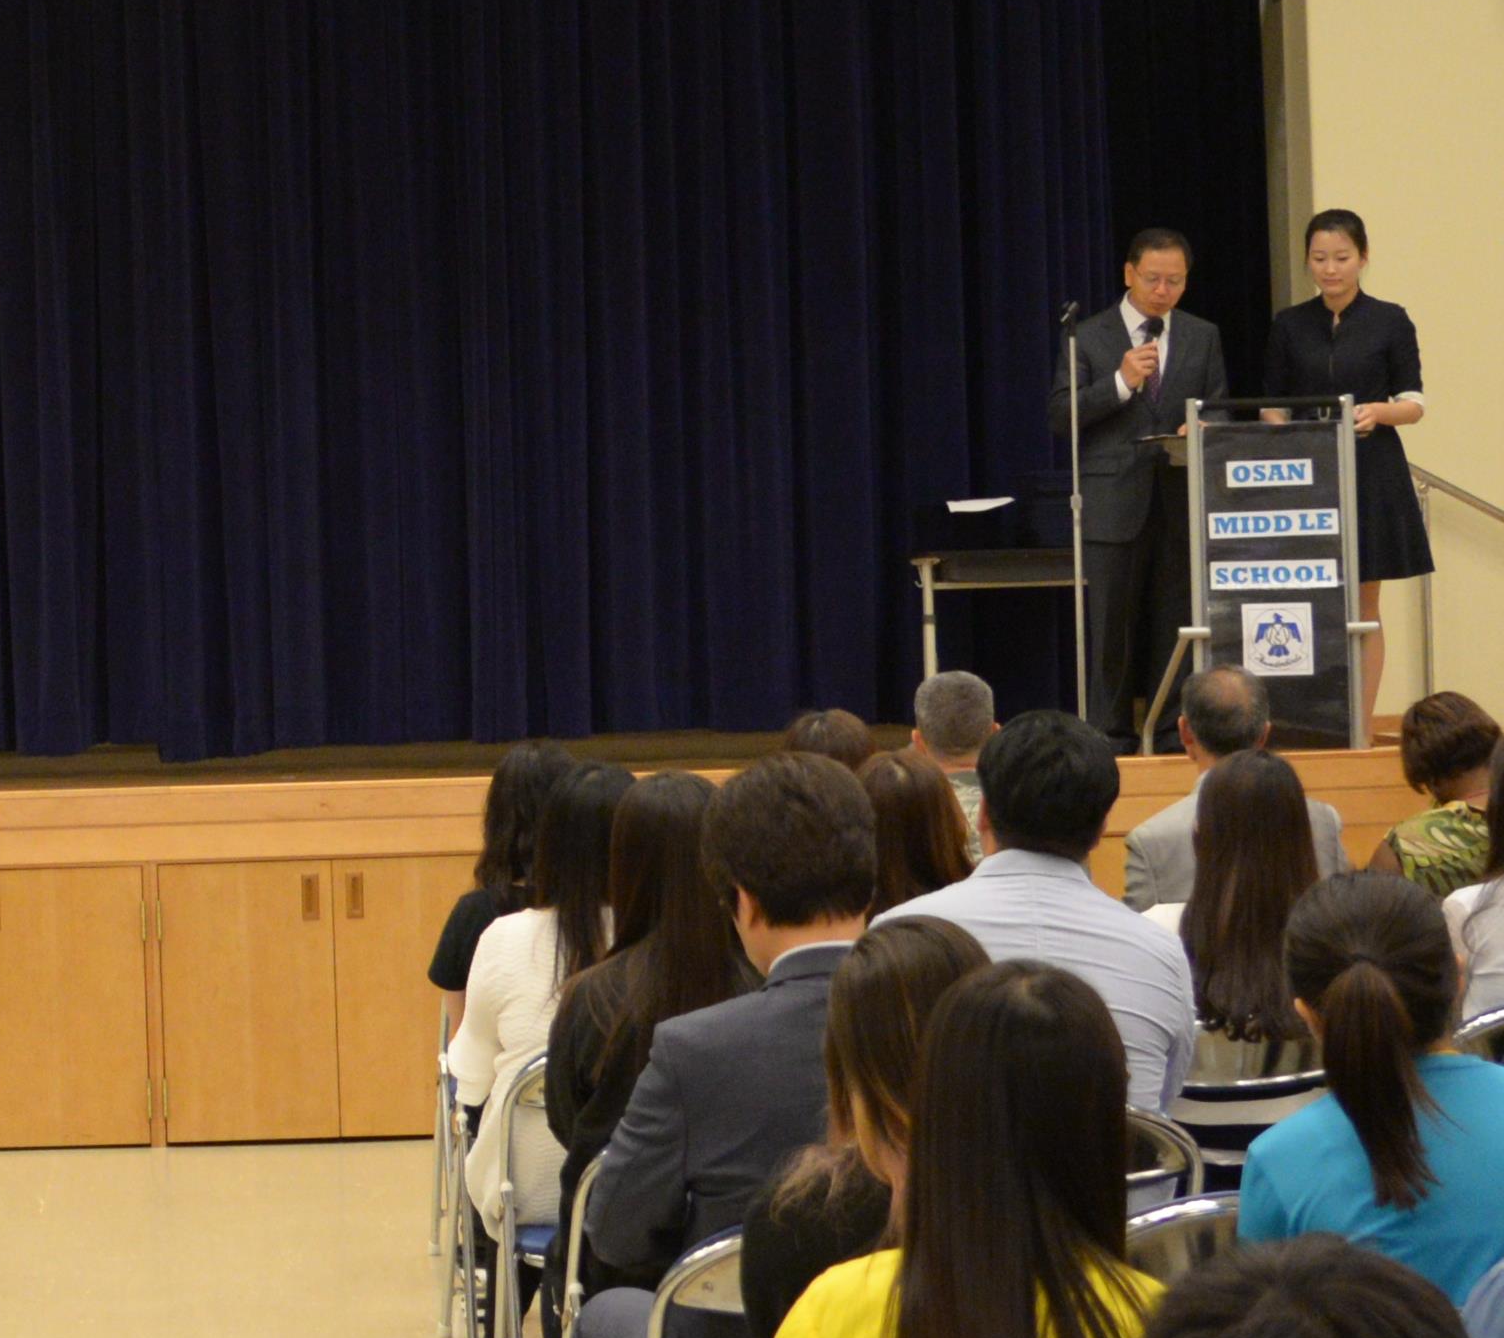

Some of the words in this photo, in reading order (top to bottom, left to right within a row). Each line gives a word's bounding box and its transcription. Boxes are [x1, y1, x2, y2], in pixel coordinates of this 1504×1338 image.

[1232, 463, 1306, 483] OSAN
[1214, 512, 1332, 534] MIDDLE
[1215, 565, 1332, 584] SCHOOL
